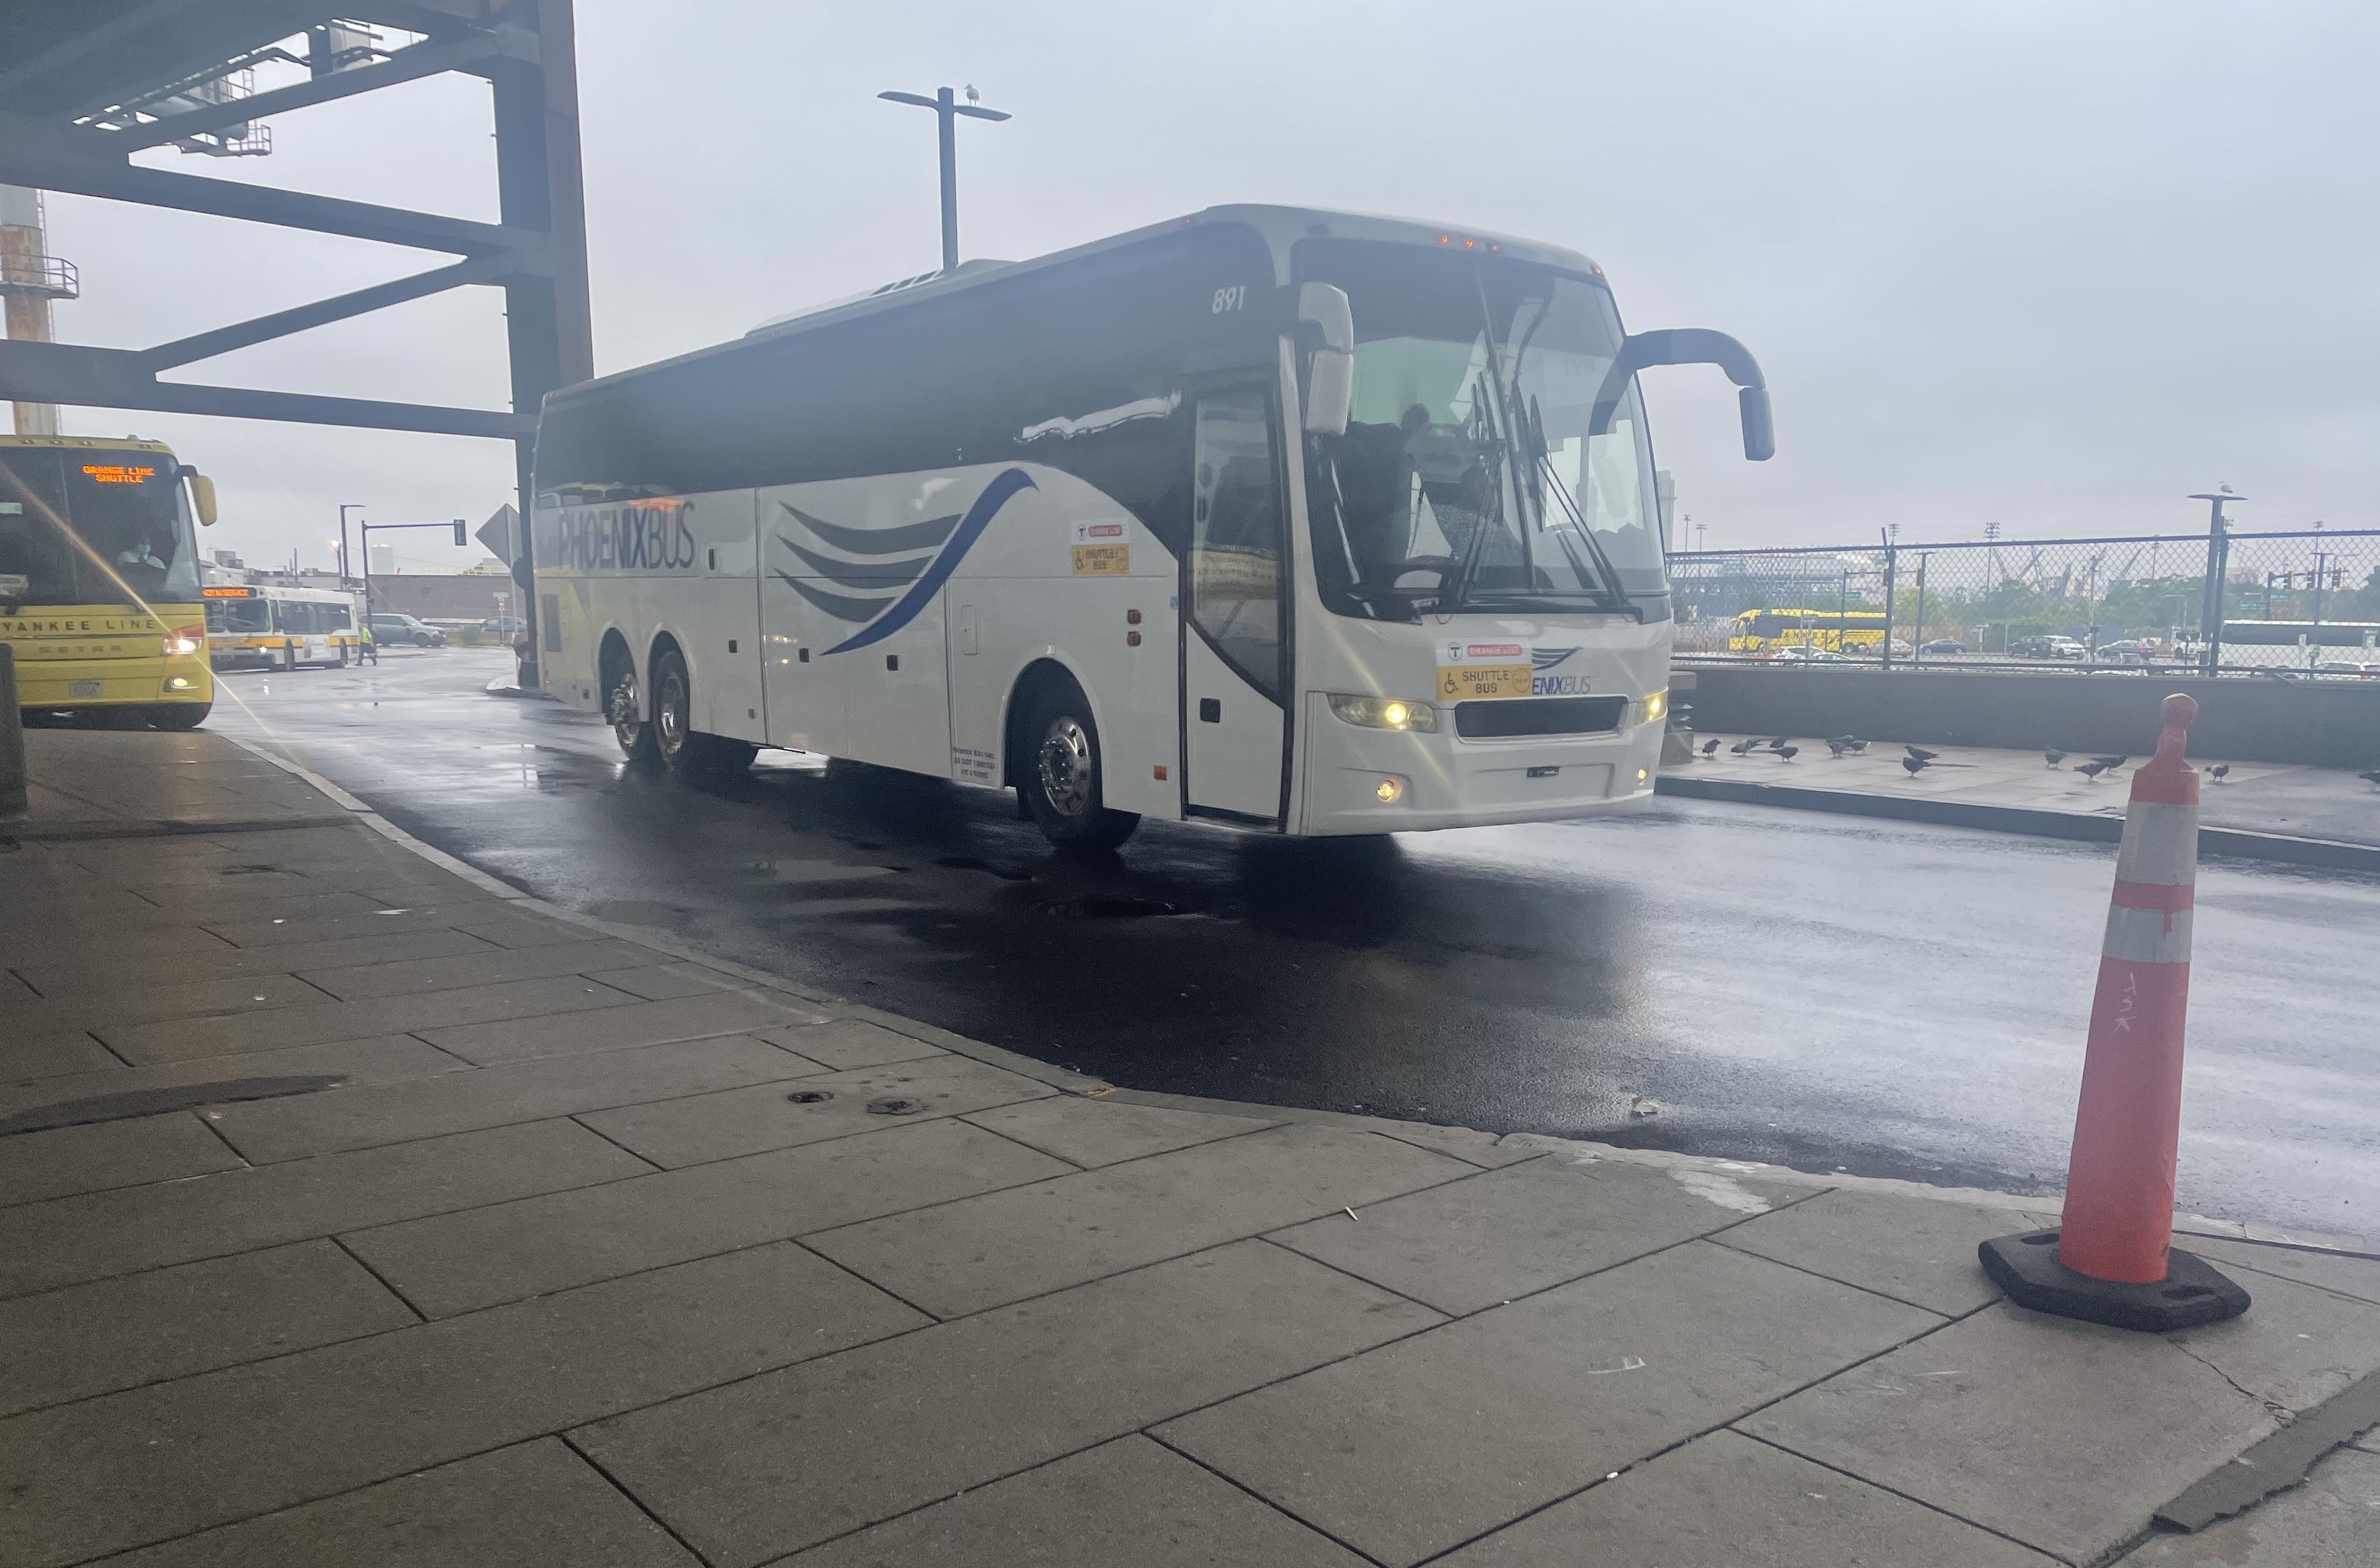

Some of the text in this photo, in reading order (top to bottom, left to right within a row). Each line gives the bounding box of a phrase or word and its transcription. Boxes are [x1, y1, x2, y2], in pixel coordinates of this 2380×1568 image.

[1212, 285, 1246, 314] 891
[95, 474, 143, 483] SHUTTLE
[1, 620, 155, 631] YANKEE LINE
[1462, 670, 1510, 682] SHUTTLE
[1475, 682, 1497, 693] BUS
[1532, 675, 1590, 695] ENIXBUS
